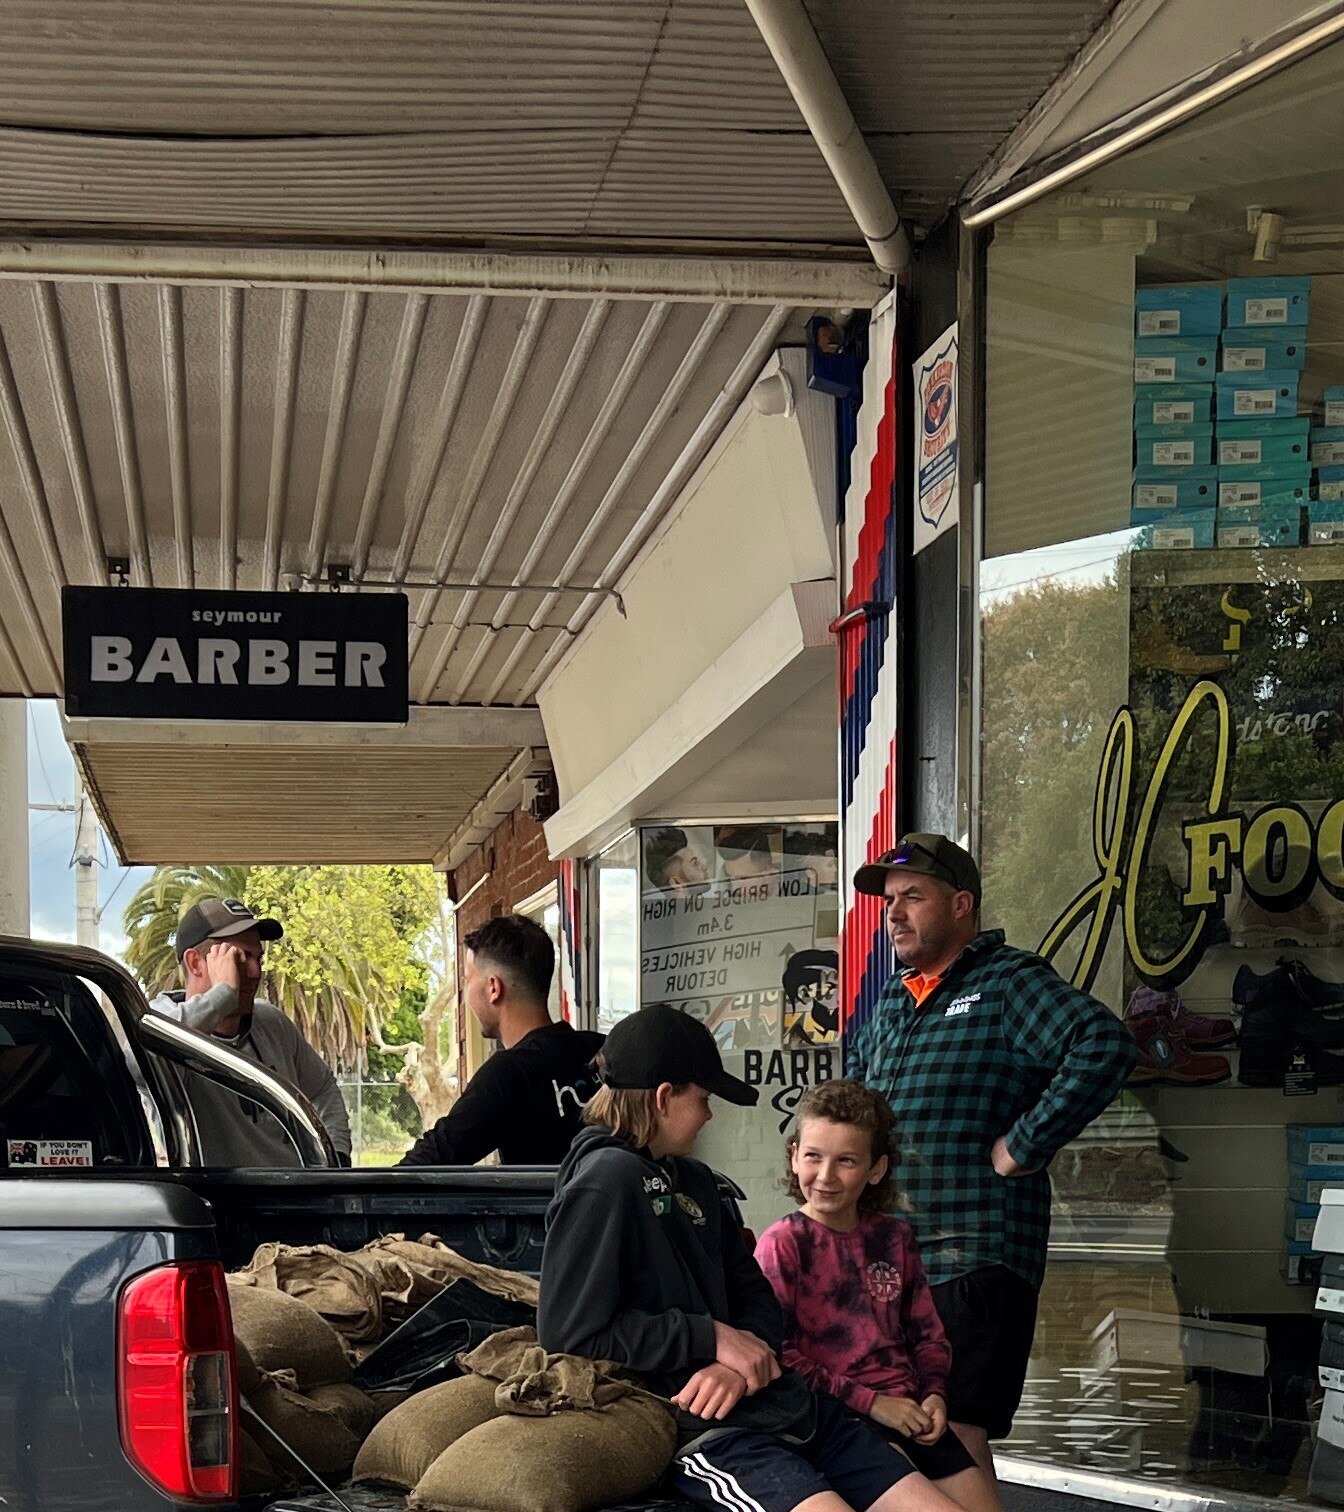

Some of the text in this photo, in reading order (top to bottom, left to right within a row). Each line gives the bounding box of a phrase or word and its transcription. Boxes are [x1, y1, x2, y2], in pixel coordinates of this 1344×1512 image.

[191, 607, 282, 625] seymour
[90, 635, 387, 688] BARBER
[744, 1049, 833, 1086] BARB
[40, 1156, 90, 1166] LEAVE!
